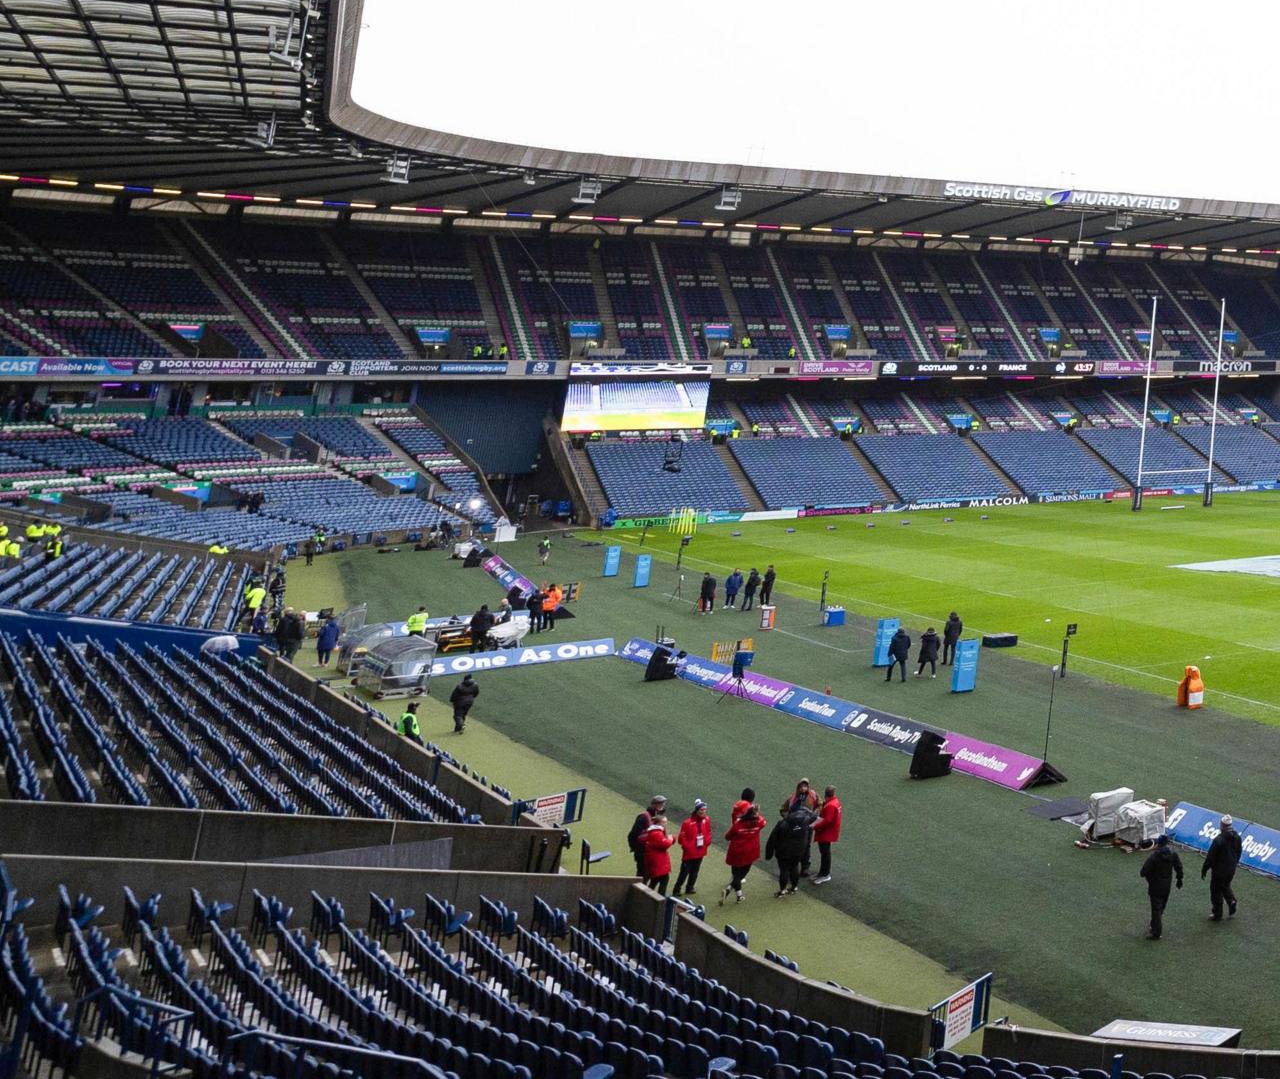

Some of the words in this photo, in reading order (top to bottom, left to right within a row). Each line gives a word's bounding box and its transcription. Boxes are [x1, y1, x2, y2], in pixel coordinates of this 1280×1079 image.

[944, 182, 1012, 199] Scottish
[1014, 188, 1042, 202] Gas
[1071, 190, 1181, 210] MURRAYFIELD
[0, 360, 36, 372] CAST
[40, 363, 82, 372] Available
[84, 363, 105, 372] Now
[160, 360, 191, 368] BOOK
[191, 360, 221, 368] YOUR
[223, 361, 249, 369] NEXT
[251, 361, 285, 369] EVENT
[286, 361, 317, 369] HERE!
[441, 364, 506, 373] scottishrugby.org
[1074, 363, 1094, 372] 43:37
[969, 496, 1029, 508] MALCOLM
[1045, 493, 1079, 503] SIMPSONS
[1079, 493, 1098, 501] MALT
[909, 501, 939, 511] NorthLink
[940, 501, 961, 509] Ferries
[519, 649, 551, 663] As
[557, 644, 609, 658] One
[451, 654, 507, 671] One
[867, 719, 894, 737] Scottish
[892, 724, 913, 744] Rugby
[955, 747, 1008, 773] @scotlandteam
[1242, 835, 1276, 862] Rugby
[1126, 1026, 1198, 1039] GUINNESS
